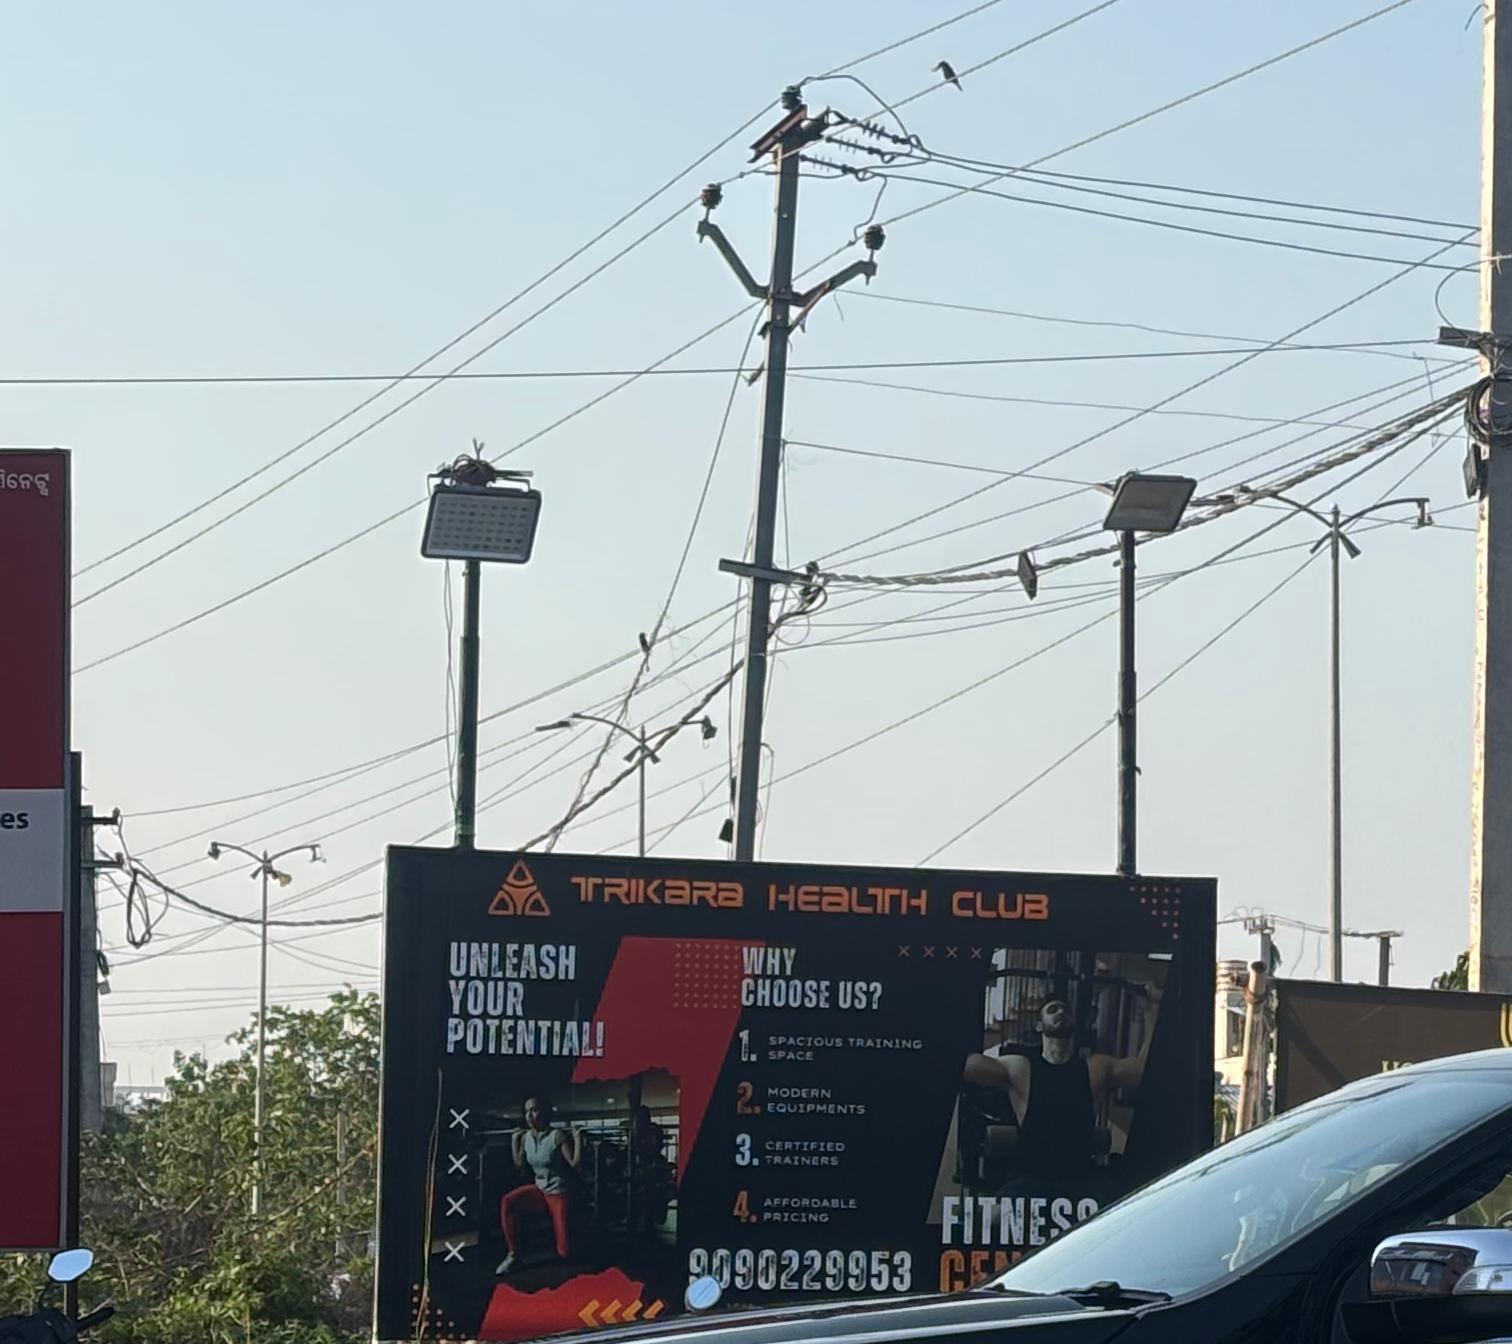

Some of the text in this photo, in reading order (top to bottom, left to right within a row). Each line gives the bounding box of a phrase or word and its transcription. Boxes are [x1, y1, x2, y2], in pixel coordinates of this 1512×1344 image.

[571, 876, 1049, 920] TRIKARA HEALTH CLUB
[450, 942, 576, 980] UNLEASH
[742, 946, 797, 976] WHY
[448, 980, 524, 1016] YOUR
[741, 978, 883, 1010] CHOOSE US?
[446, 1018, 606, 1057] POTENTIAL!
[768, 1036, 844, 1047] SPACIOUS
[848, 1038, 923, 1049] TRAINING
[768, 1051, 814, 1061] SPACE
[767, 1087, 832, 1098] MODERN
[766, 1103, 866, 1114] EQUIPMENTS
[735, 1133, 846, 1166] 3. CERTIFIED
[765, 1155, 839, 1166] TRAINERS
[763, 1198, 857, 1208] AFFORDABLE
[763, 1211, 830, 1223] PRICING
[688, 1248, 913, 1292] 9090229953
